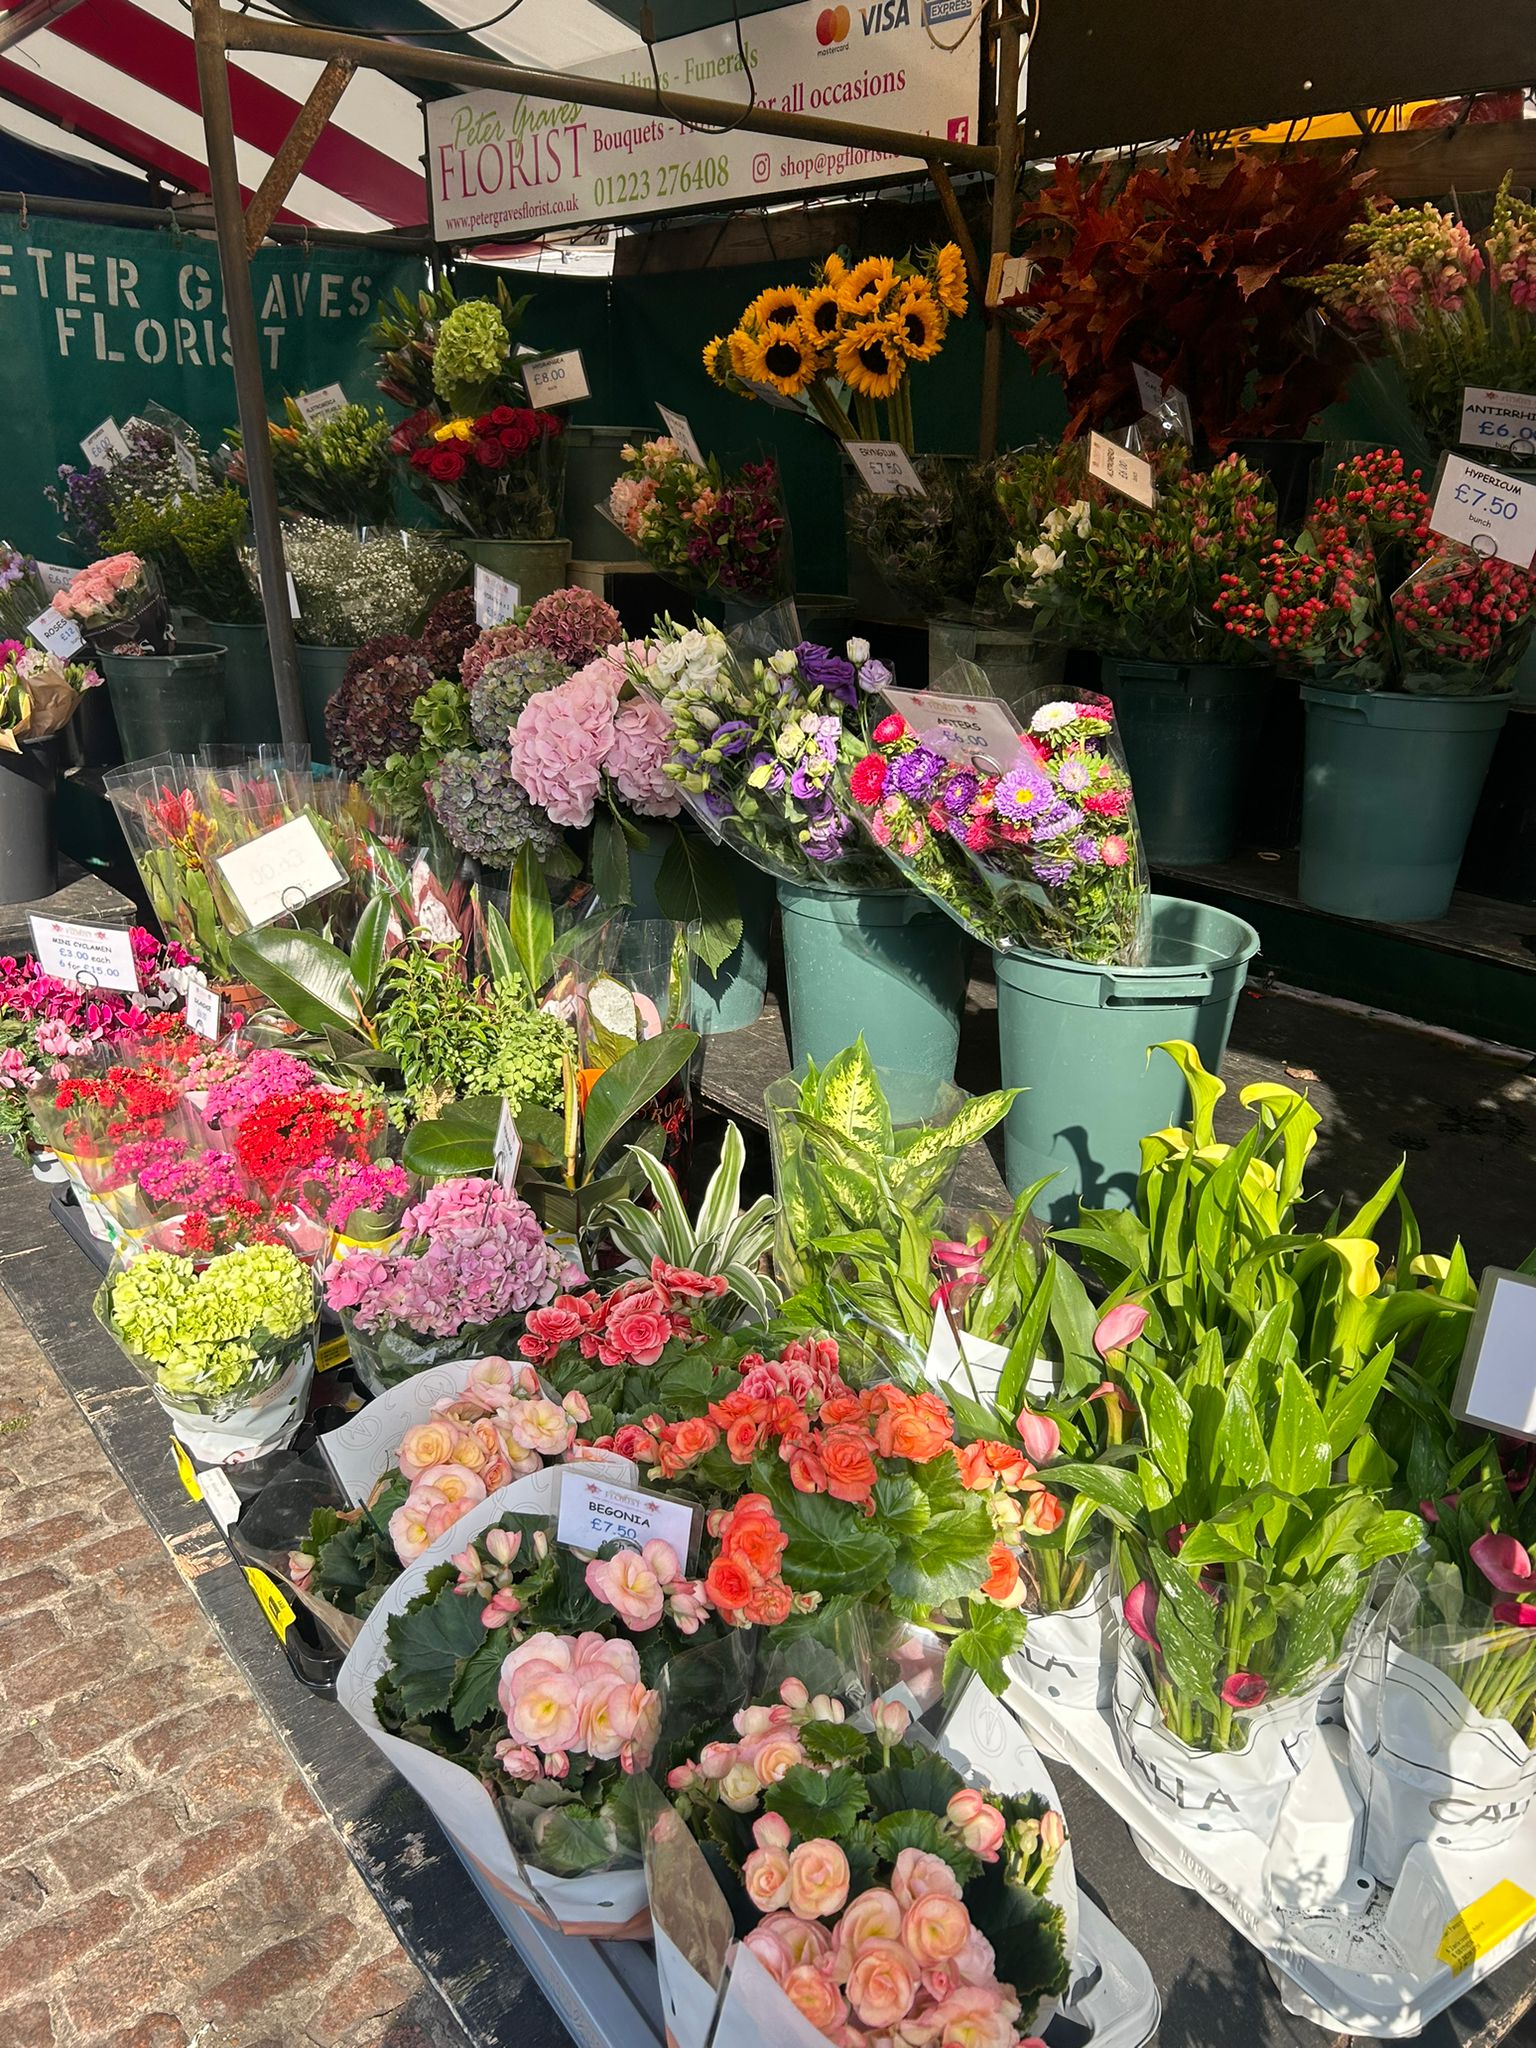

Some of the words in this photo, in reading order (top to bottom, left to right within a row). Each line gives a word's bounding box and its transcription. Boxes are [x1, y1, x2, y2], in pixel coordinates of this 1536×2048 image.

[858, 0, 910, 36] VISA
[931, 0, 972, 17] EXPRESS
[817, 43, 849, 57] mastercard
[684, 42, 758, 84] Funerals
[810, 69, 906, 109] occasions
[451, 105, 505, 150] Peter
[512, 95, 582, 159] Graves
[593, 120, 664, 155] Bouquets
[438, 122, 588, 202] FLORIST
[594, 169, 650, 207] 01223
[657, 154, 729, 197] 276408
[445, 193, 579, 232] www.petergravesflorist.co.uk
[178, 264, 373, 320] GAVES
[533, 368, 566, 385] £8.00
[1464, 466, 1522, 495] HYPERICUM
[1454, 483, 1518, 520] £7.50
[1468, 513, 1492, 528] bunch
[44, 619, 67, 638] ROSES
[60, 627, 75, 641] £12
[937, 718, 982, 731] ASTERS
[943, 730, 988, 747] £6.00
[59, 948, 89, 960] £3.00
[91, 956, 111, 964] each
[73, 941, 112, 953] CYCLAMEN
[83, 964, 119, 977] £15.00
[588, 1501, 651, 1528] BEGONIA
[590, 1518, 637, 1540] £7.50
